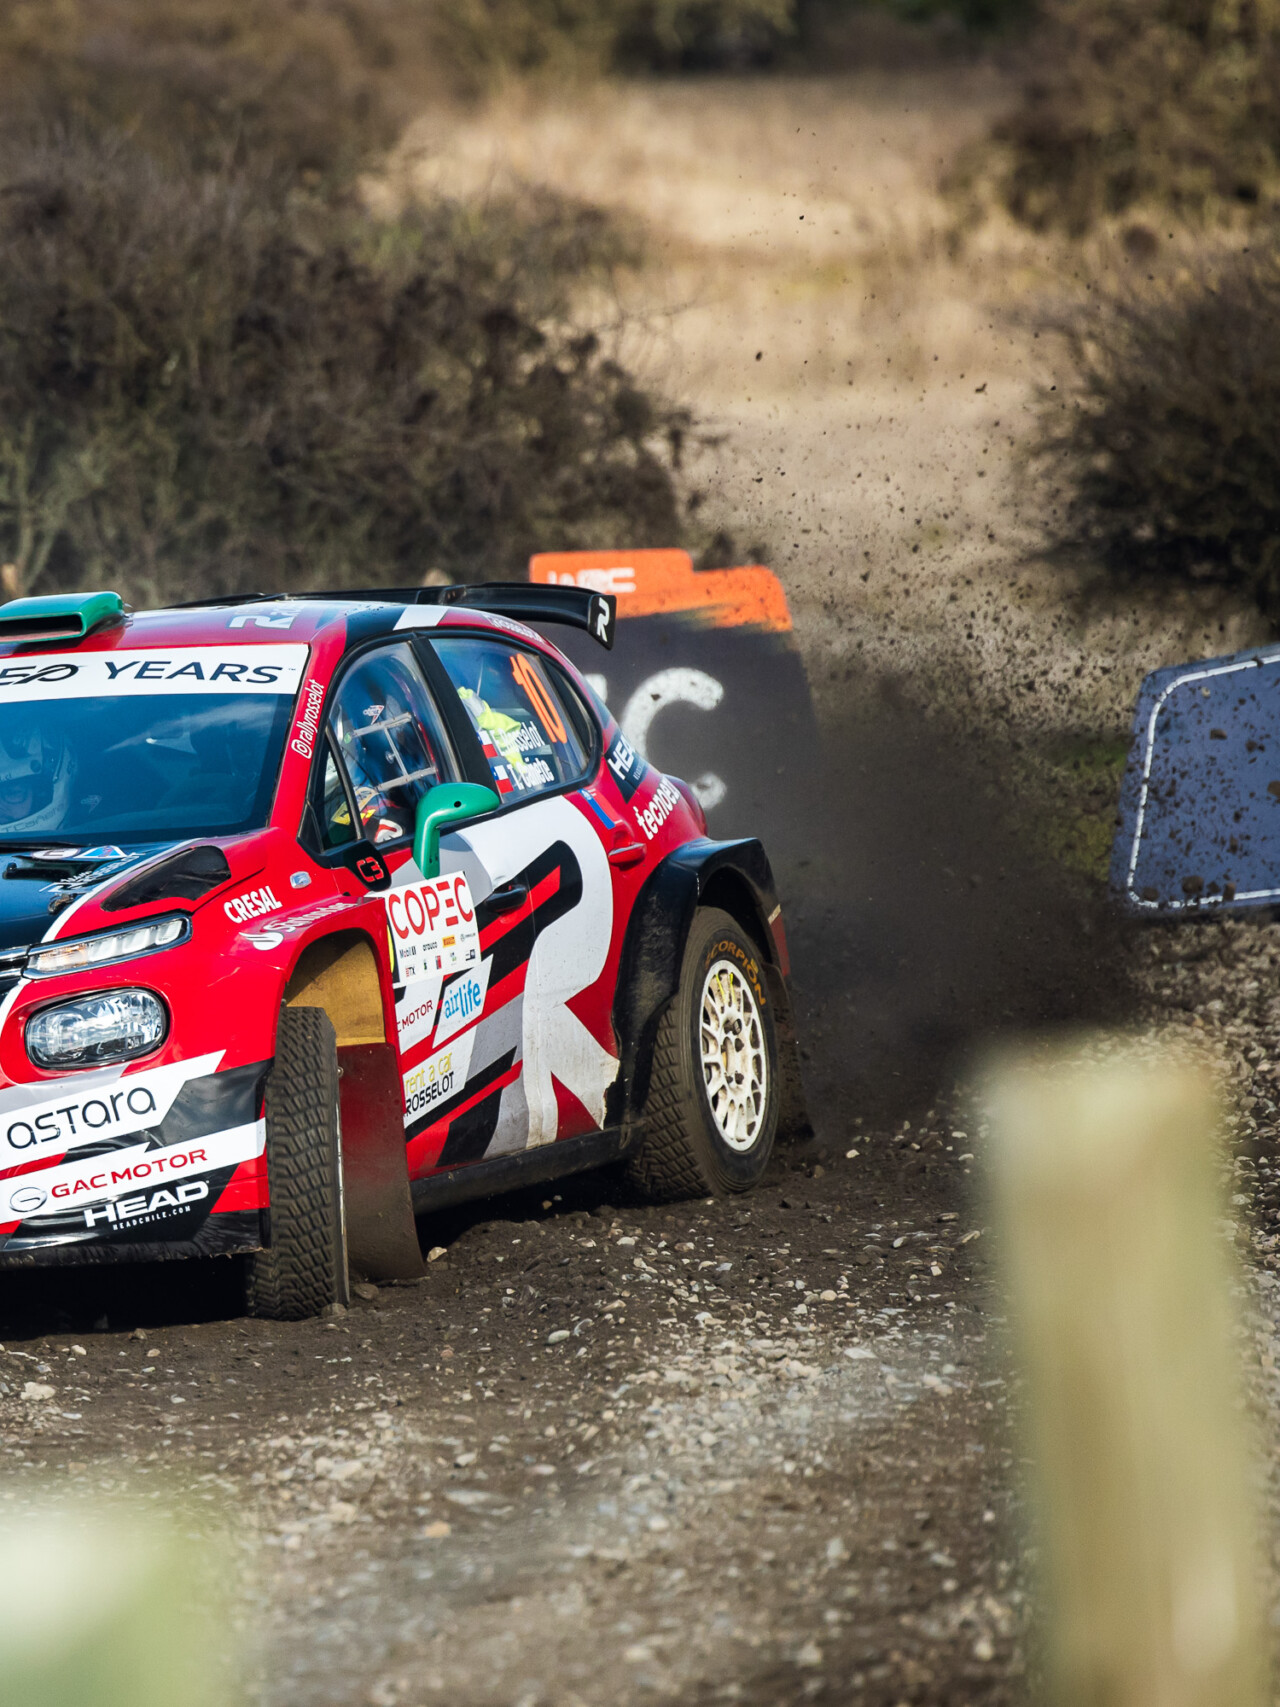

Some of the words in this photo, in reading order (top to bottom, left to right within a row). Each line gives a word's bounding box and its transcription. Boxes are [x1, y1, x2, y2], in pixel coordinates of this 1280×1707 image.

[104, 661, 283, 684] YEARS
[290, 679, 325, 759] @rallyrosselot
[509, 653, 568, 744] 10
[356, 856, 385, 883] C3
[223, 885, 283, 924] CRESAL
[388, 876, 474, 940] COPEC
[402, 1000, 433, 1030] MOTOR
[443, 979, 482, 1019] airlife
[403, 1071, 454, 1118] ROSSELOT
[405, 1068, 425, 1097] rent
[428, 1064, 436, 1083] a
[438, 1052, 452, 1076] car
[6, 1087, 157, 1149] astara
[51, 1174, 107, 1199] GAC
[111, 1149, 208, 1184] MOTOR
[83, 1180, 209, 1228] HEAD
[112, 1205, 192, 1231] HEADCHILE.COM
